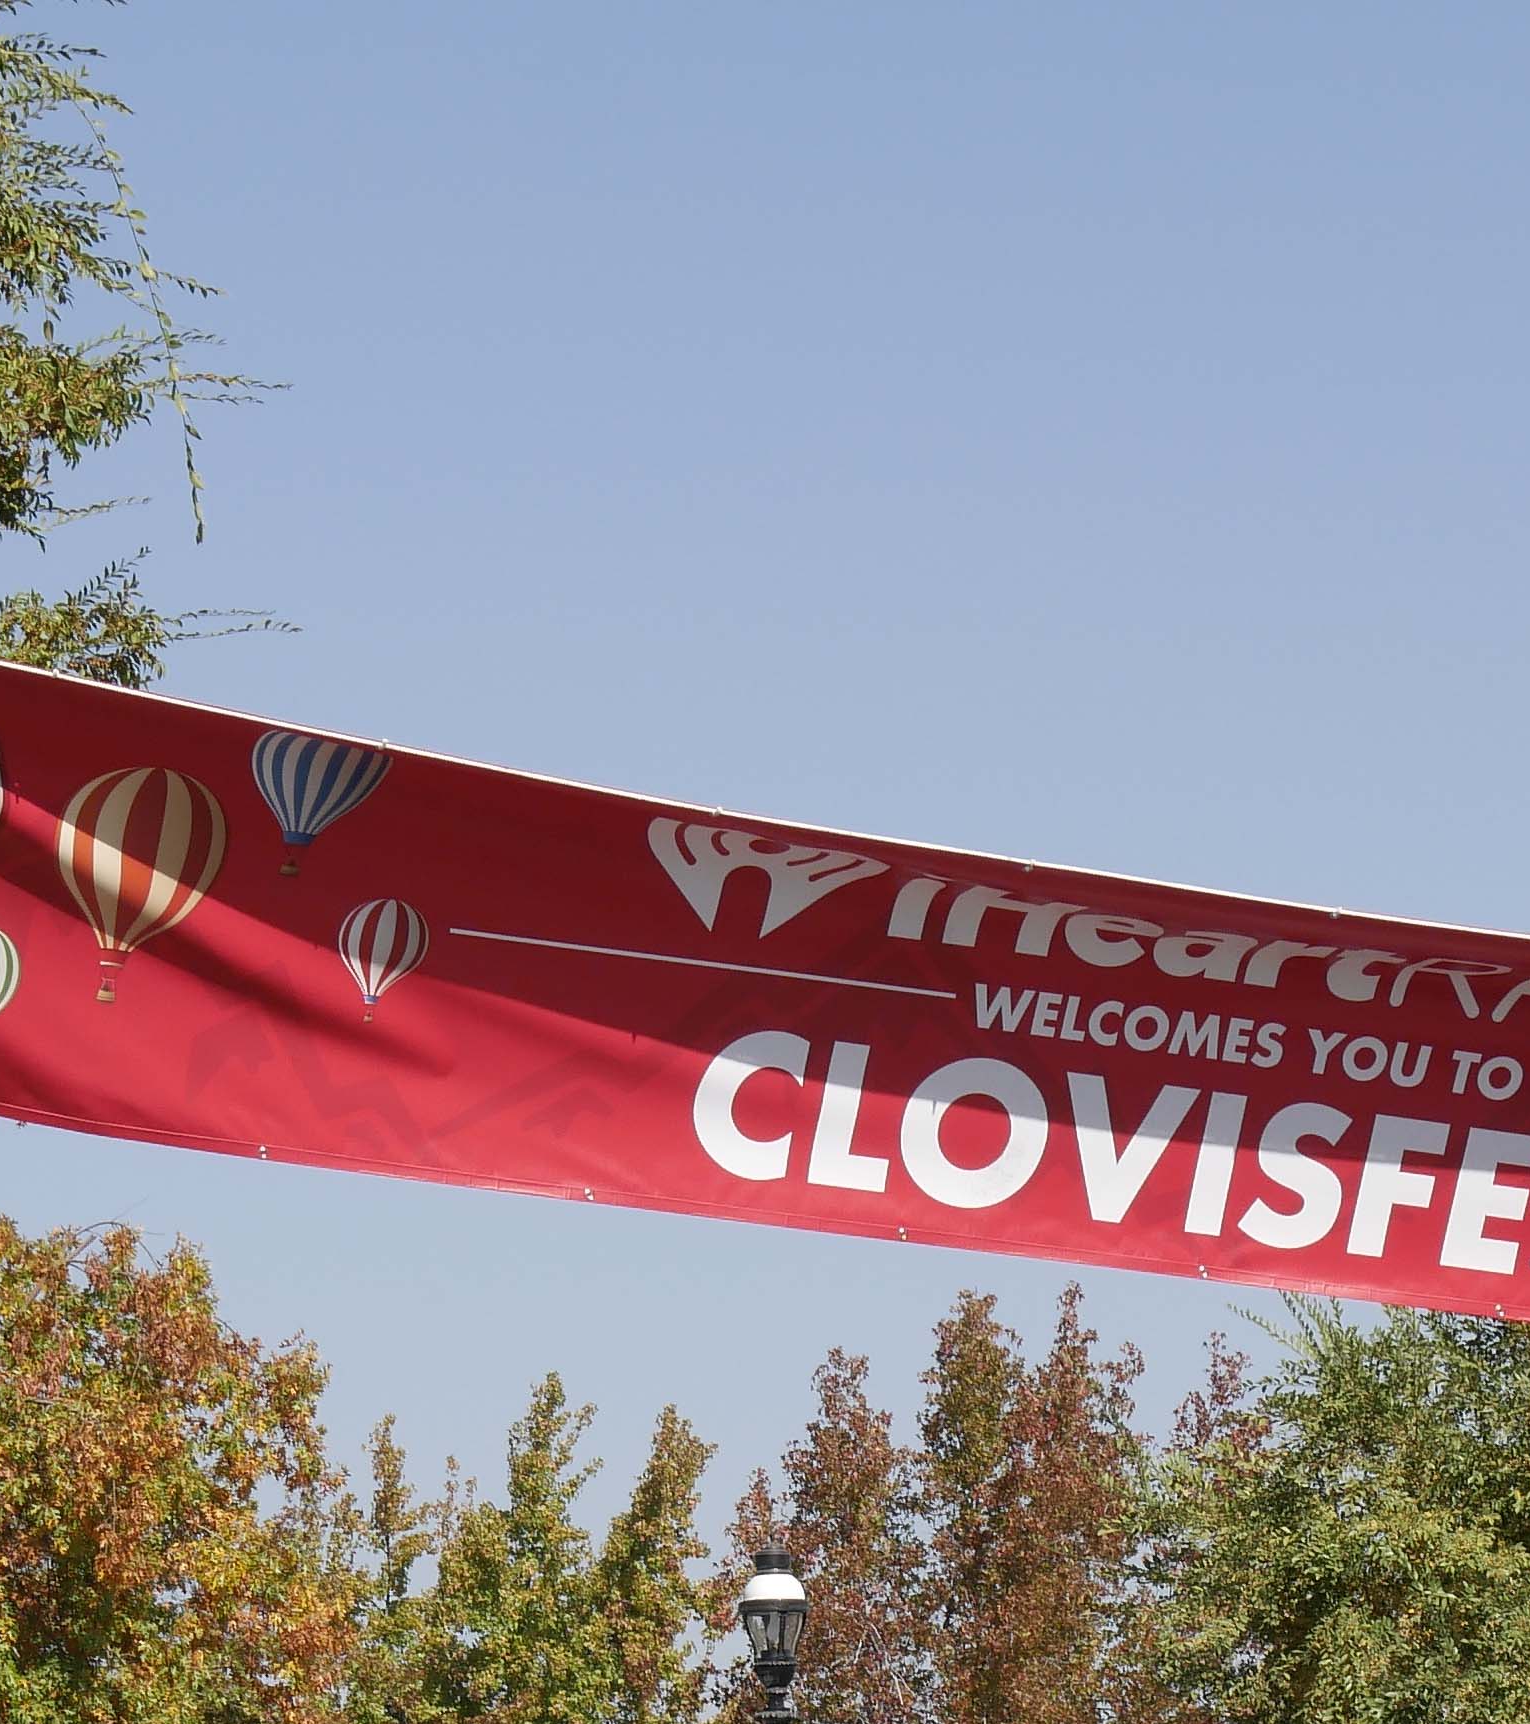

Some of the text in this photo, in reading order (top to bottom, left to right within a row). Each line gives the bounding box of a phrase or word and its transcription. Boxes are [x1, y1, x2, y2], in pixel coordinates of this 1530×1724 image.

[974, 983, 1524, 1101] WELCOMES YOU TO
